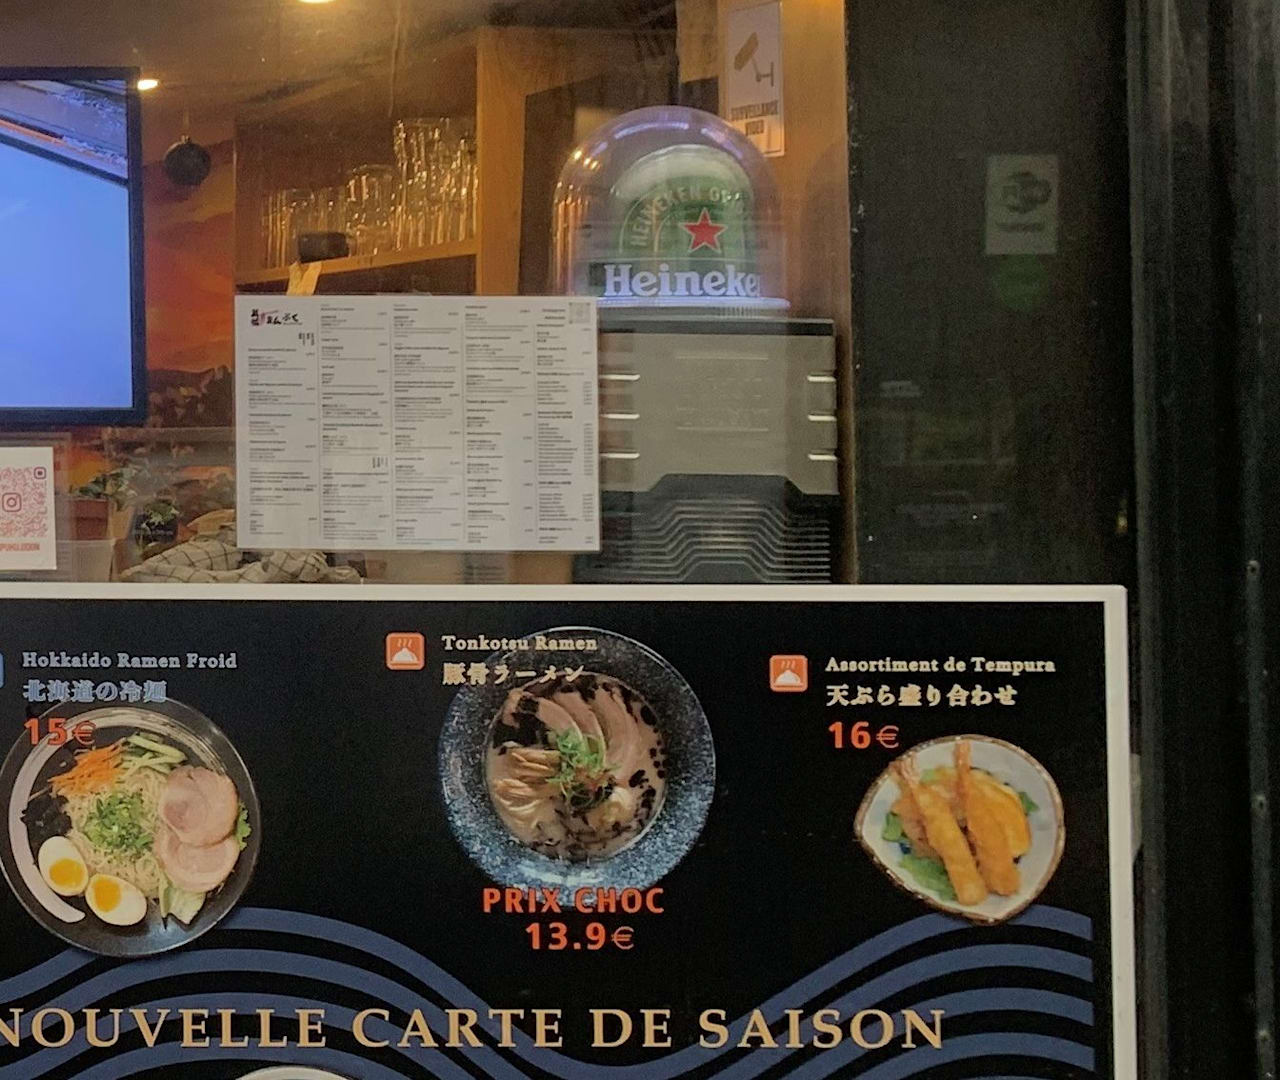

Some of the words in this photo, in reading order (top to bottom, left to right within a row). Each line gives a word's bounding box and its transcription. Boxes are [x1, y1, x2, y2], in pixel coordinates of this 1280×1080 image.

[602, 262, 762, 298] Heineke
[441, 635, 529, 651] Tonkotsu
[535, 636, 598, 651] Ramen
[21, 651, 112, 668] Hokkaido
[117, 652, 181, 668] Ramen
[186, 652, 238, 668] Froid
[825, 656, 939, 672] Assortiment
[943, 656, 966, 672] de
[971, 657, 1056, 676] Tempura
[23, 717, 97, 746] 15€
[827, 721, 900, 749] 16€
[482, 887, 559, 914] PRIX
[574, 887, 666, 914] CHOC
[524, 922, 635, 951] 13.9€
[351, 1008, 565, 1049] CARTE
[591, 1010, 673, 1048] DE
[698, 1008, 946, 1050] SAISON
